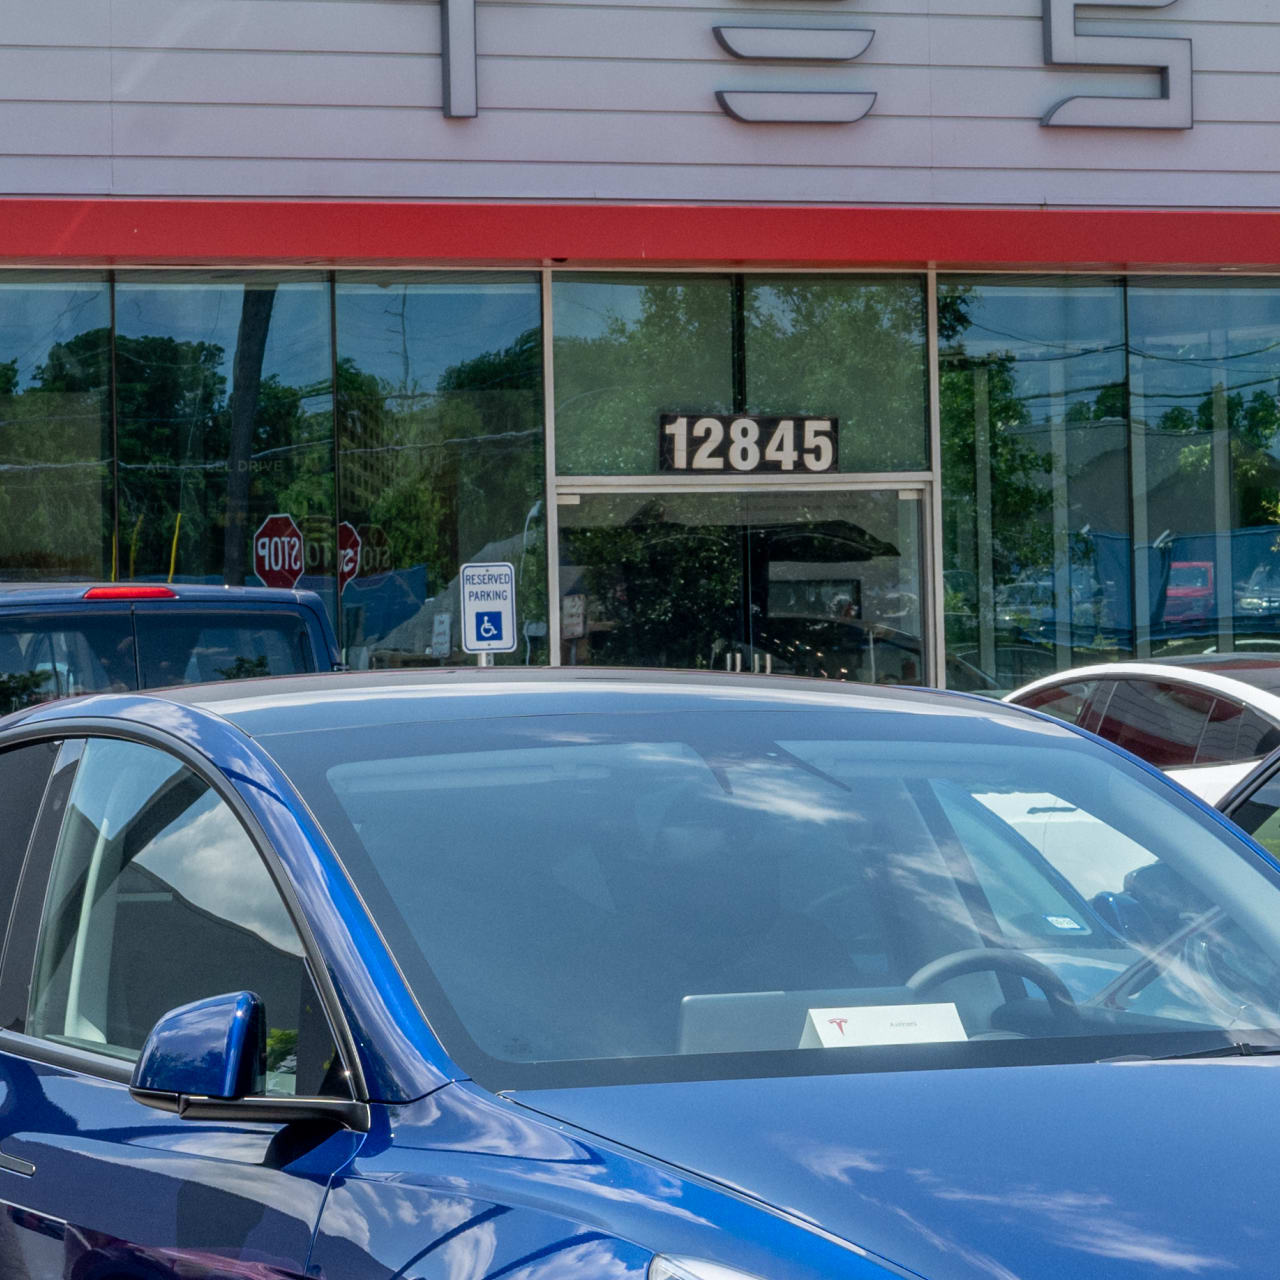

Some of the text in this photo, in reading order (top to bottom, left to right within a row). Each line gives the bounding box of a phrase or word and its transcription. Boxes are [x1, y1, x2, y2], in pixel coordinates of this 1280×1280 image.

[665, 416, 832, 471] 12845
[465, 573, 510, 585] RESERVED
[468, 590, 508, 602] PARKING
